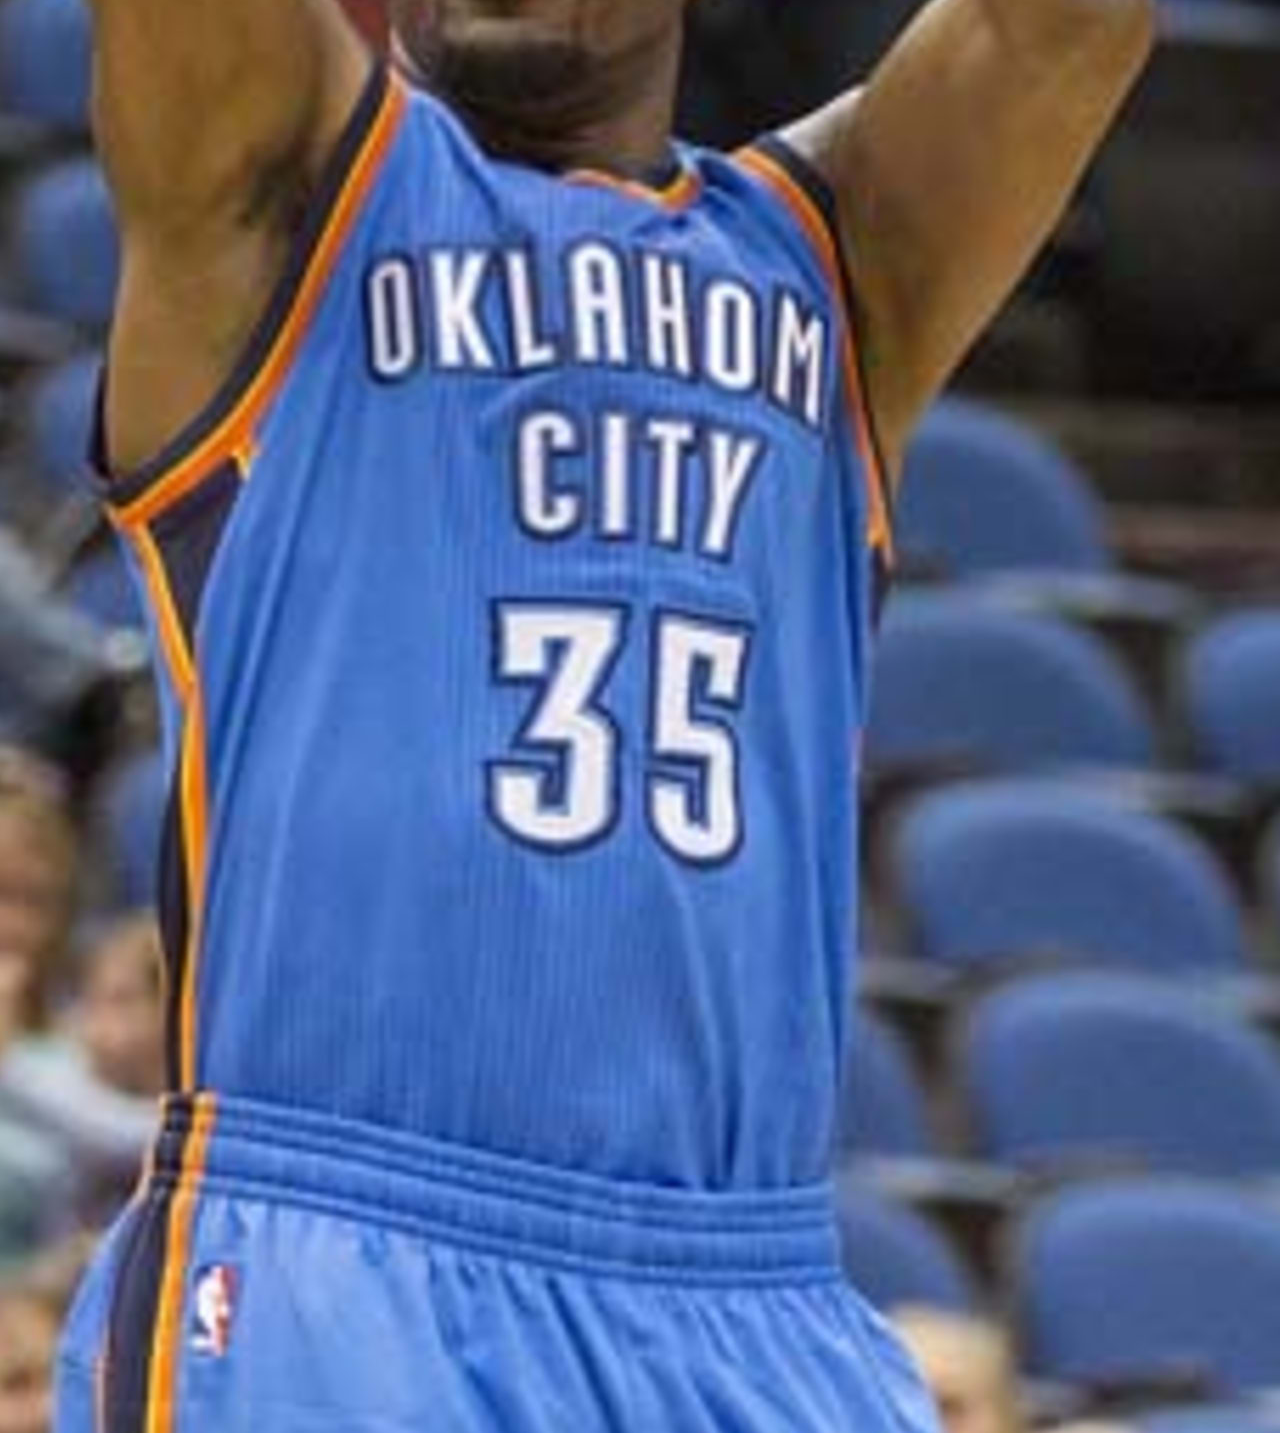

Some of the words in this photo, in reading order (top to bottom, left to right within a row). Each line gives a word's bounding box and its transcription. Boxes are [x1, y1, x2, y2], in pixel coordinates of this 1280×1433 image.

[361, 239, 826, 433] OKLAHOM
[517, 404, 770, 564] CITY
[484, 597, 754, 868] 35
